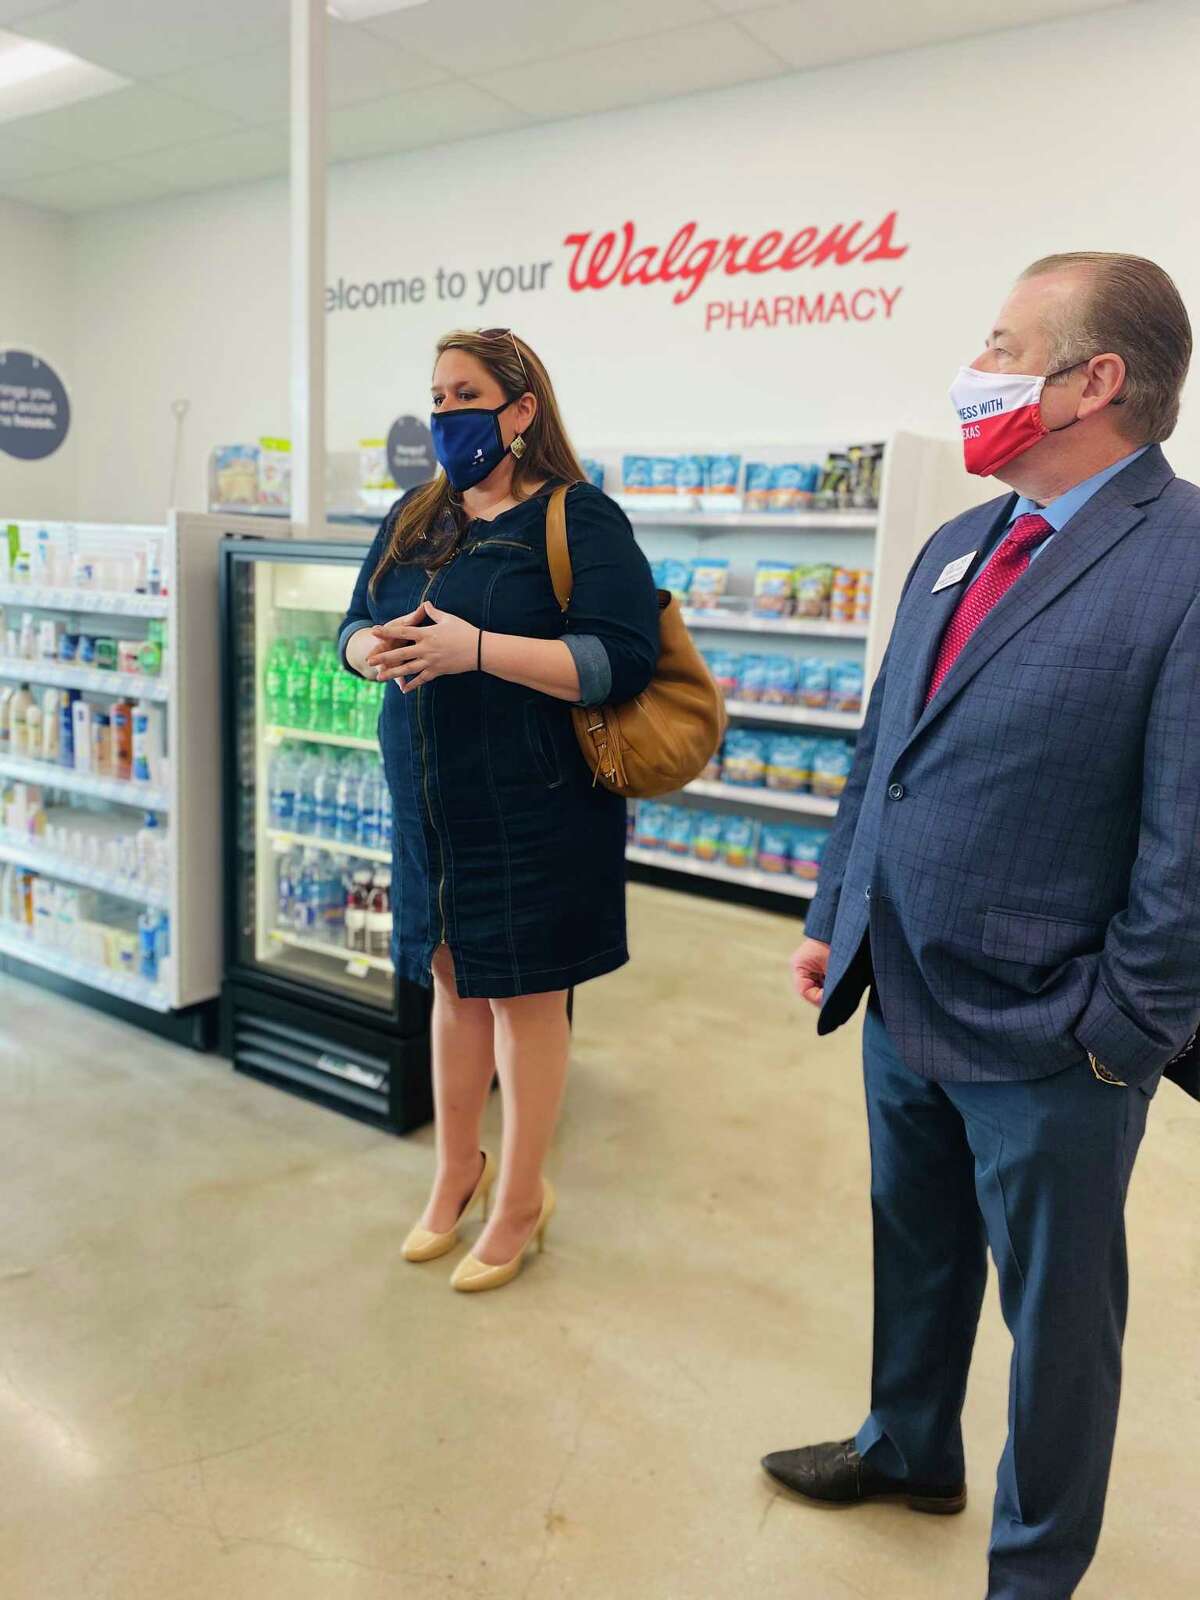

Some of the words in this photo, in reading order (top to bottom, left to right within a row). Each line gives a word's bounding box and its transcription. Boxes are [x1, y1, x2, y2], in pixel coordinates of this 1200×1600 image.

[324, 277, 425, 312] elcome
[436, 267, 466, 300] to
[477, 260, 552, 306] your
[564, 211, 909, 305] Walgreens
[705, 286, 903, 332] PHARMACY
[979, 398, 1003, 415] WITH
[961, 425, 981, 440] EXAS
